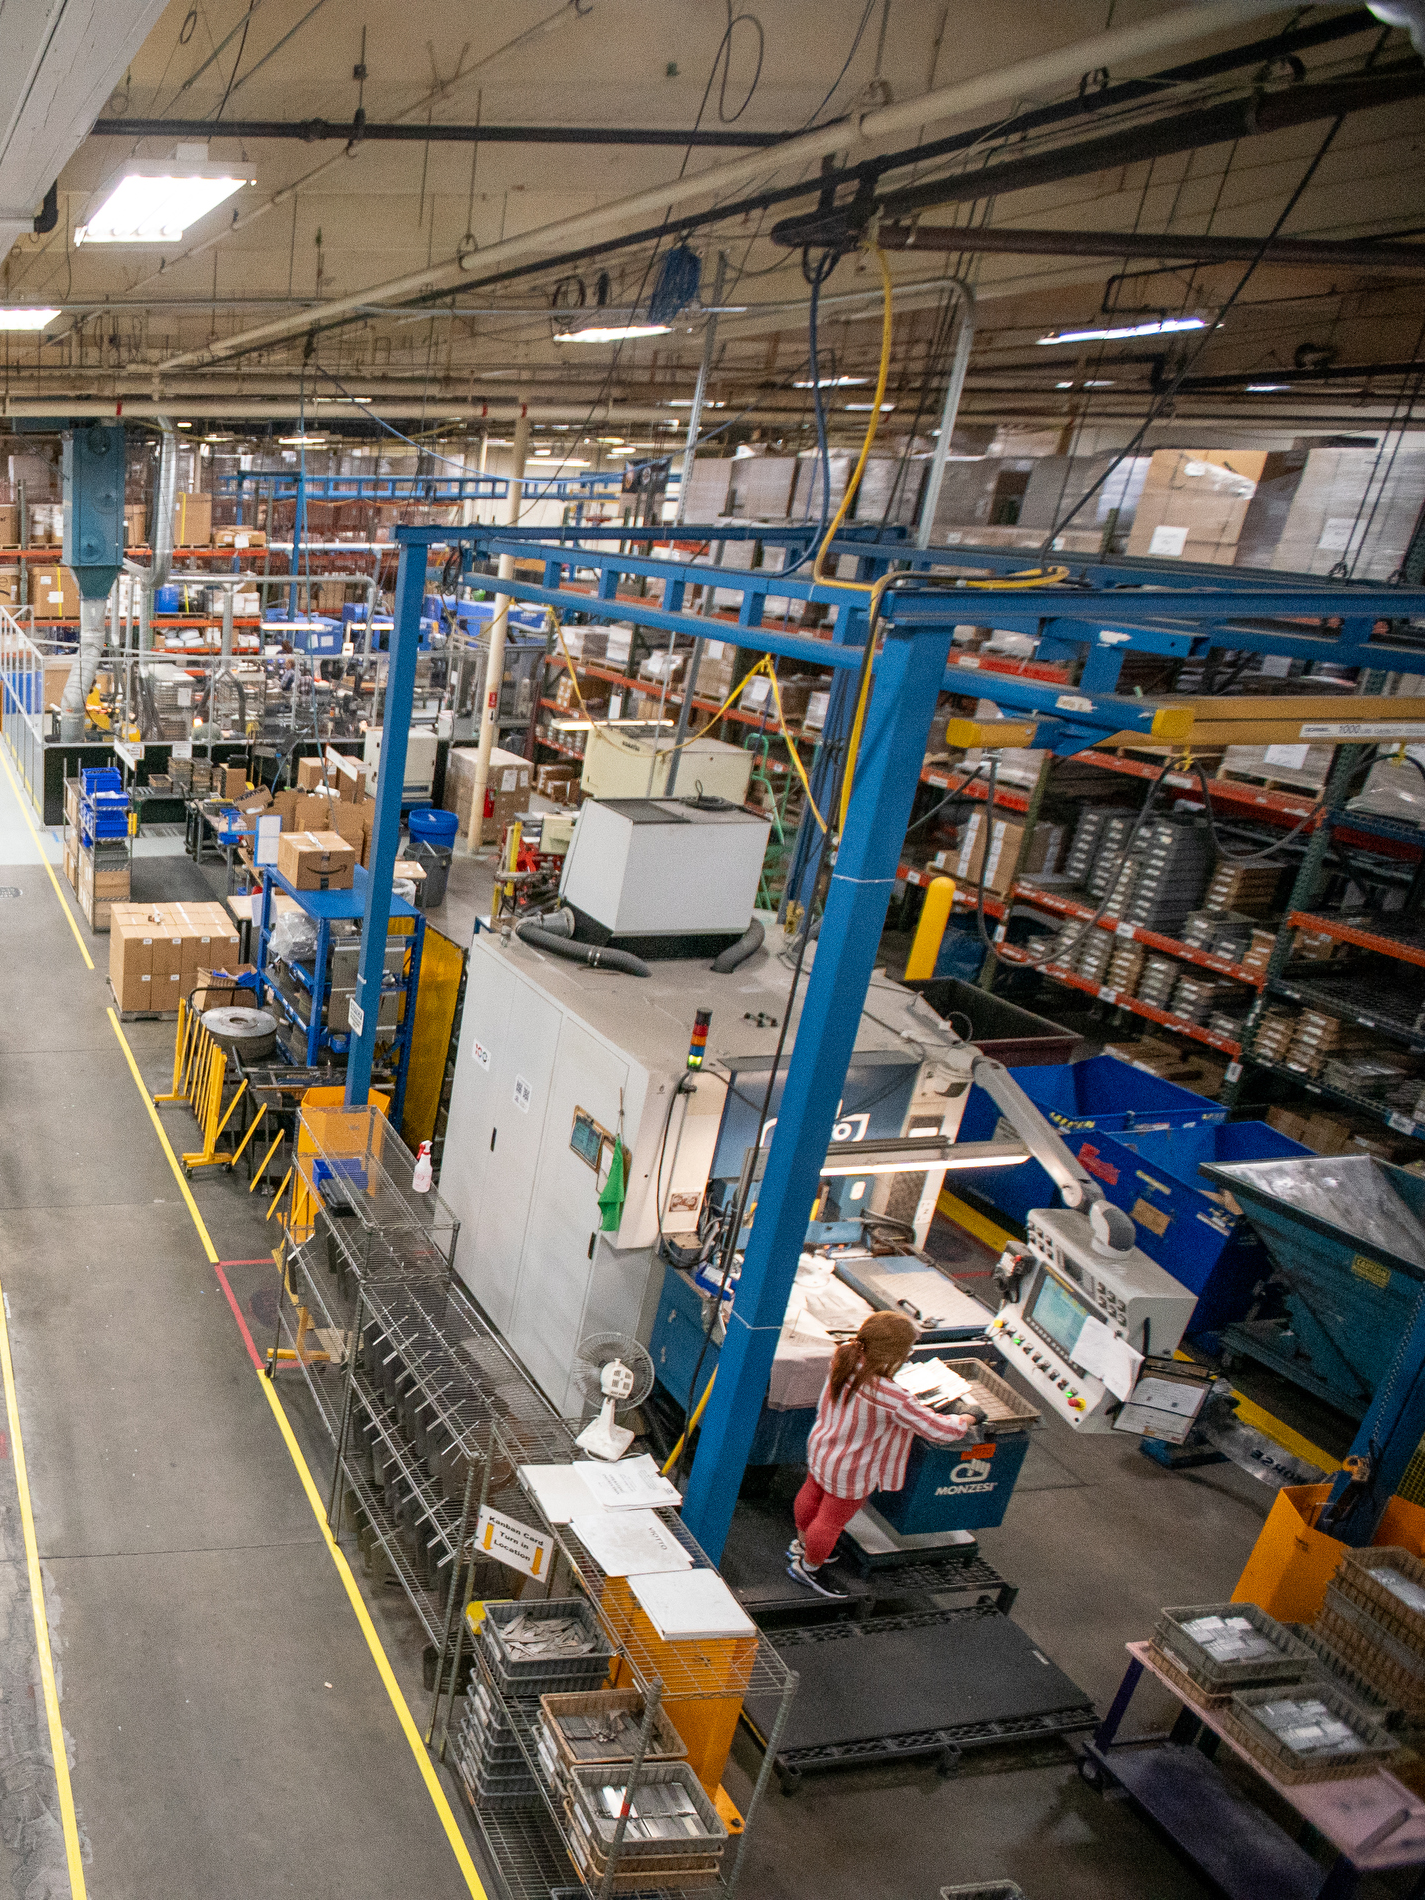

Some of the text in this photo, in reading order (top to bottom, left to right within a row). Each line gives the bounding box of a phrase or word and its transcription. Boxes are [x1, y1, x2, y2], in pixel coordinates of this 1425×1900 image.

[934, 1482, 995, 1495] MONZESI
[489, 1516, 544, 1546] Kanban Card
[500, 1531, 529, 1550] Turn in
[494, 1539, 531, 1561] Location
